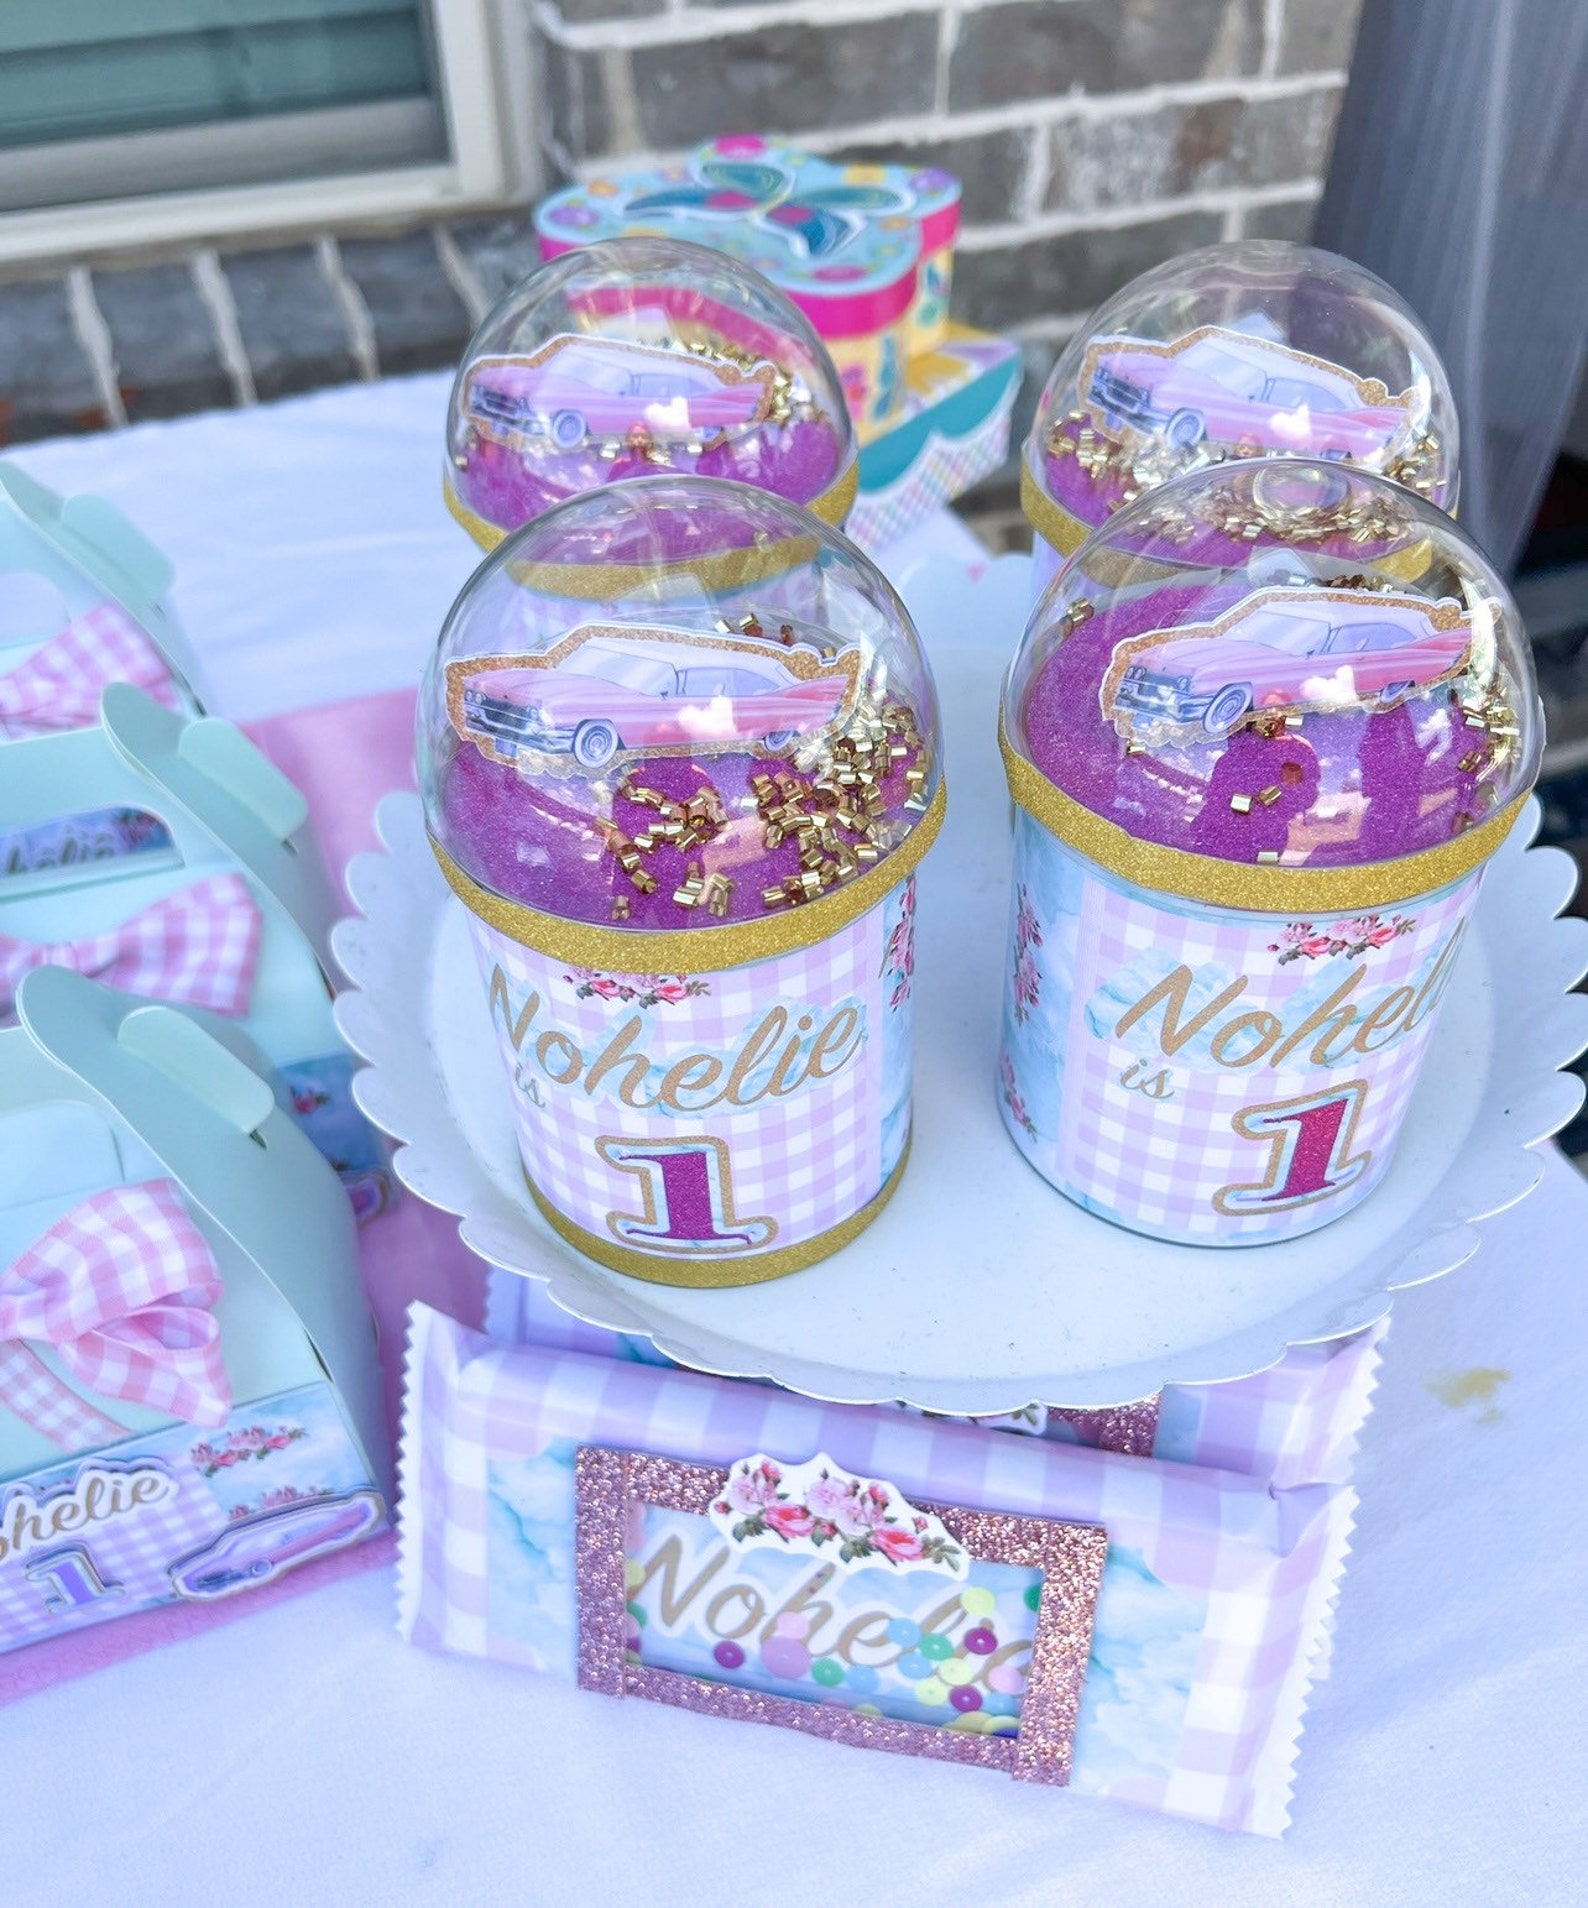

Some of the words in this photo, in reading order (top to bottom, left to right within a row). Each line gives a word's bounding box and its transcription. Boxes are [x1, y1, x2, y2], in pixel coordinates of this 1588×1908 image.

[490, 963, 866, 1112] Nohelie
[1120, 1058, 1175, 1099] is
[594, 1135, 778, 1254] 1
[1212, 1078, 1373, 1216] 1
[25, 1549, 127, 1614] 1
